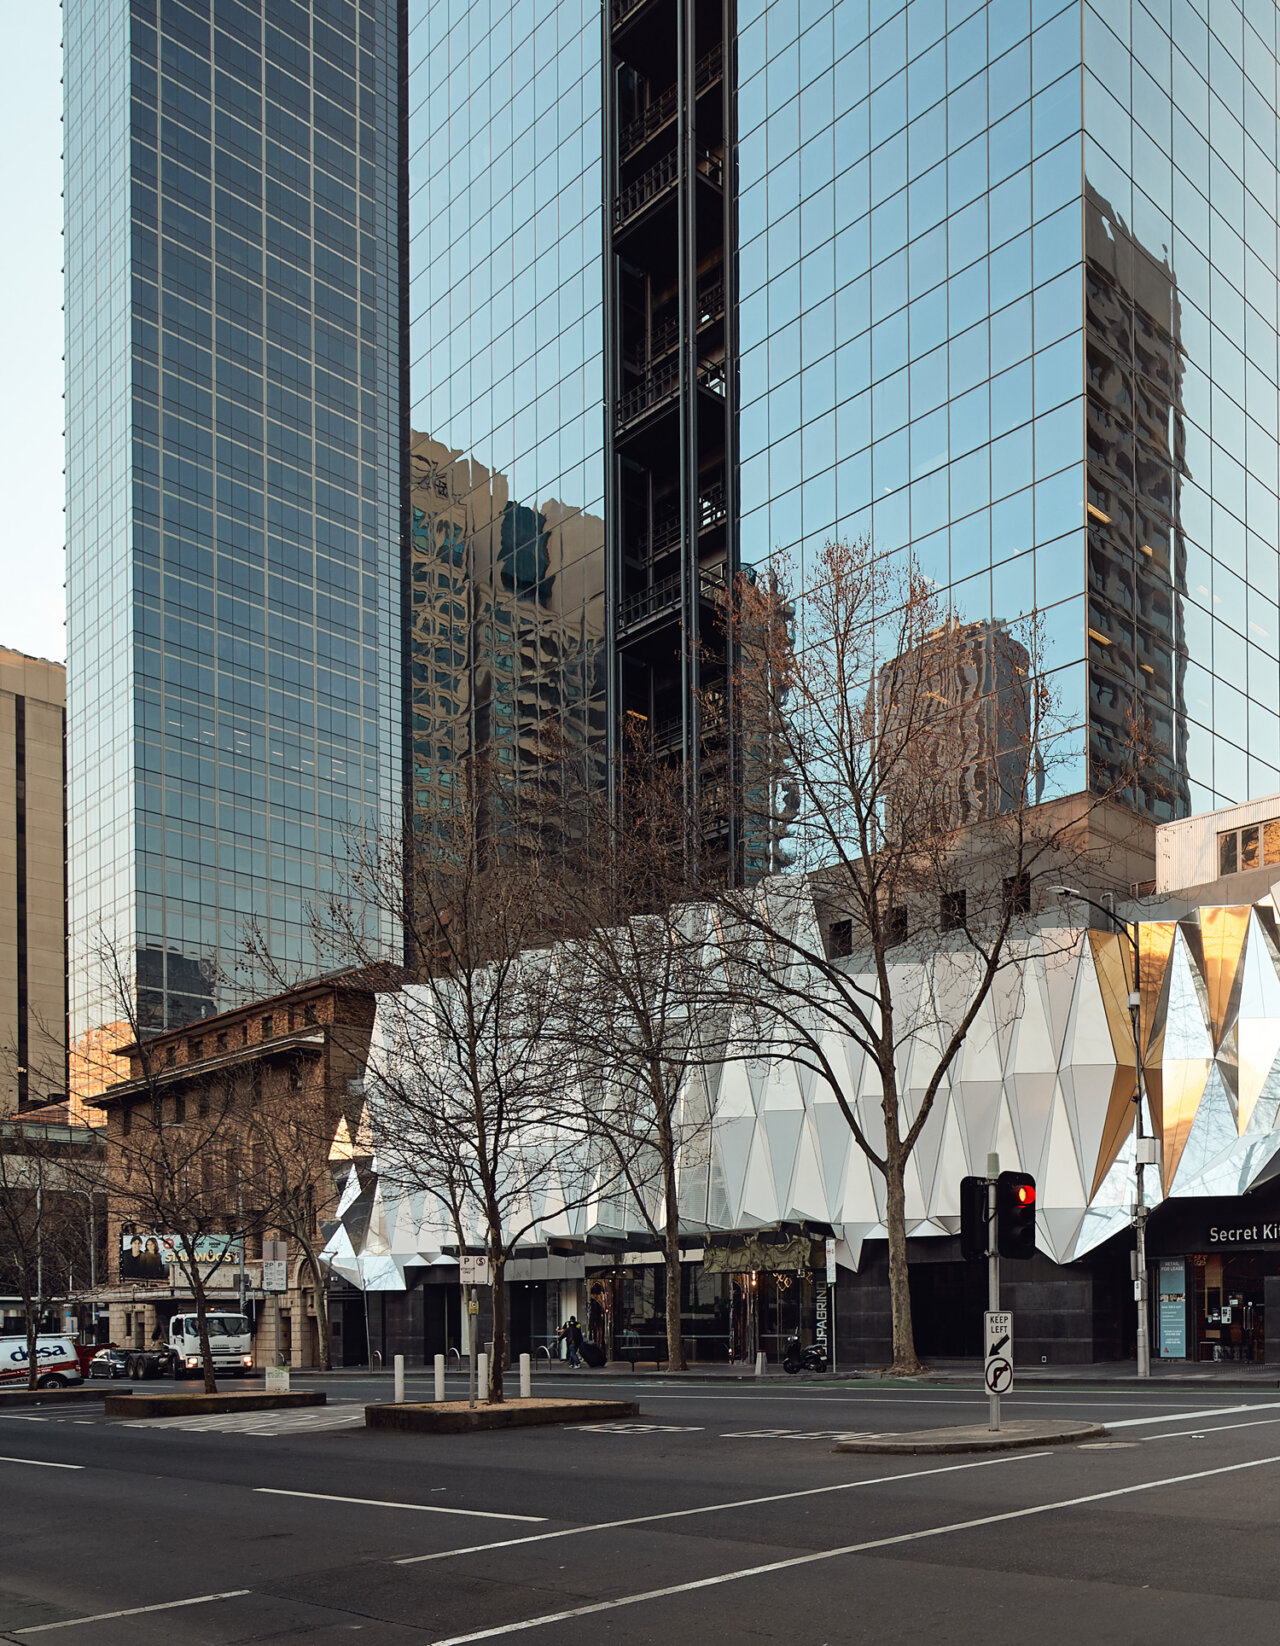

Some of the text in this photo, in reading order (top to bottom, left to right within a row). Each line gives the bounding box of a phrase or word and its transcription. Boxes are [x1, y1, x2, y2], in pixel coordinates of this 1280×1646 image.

[1210, 1226, 1258, 1242] Secret
[464, 1257, 470, 1265] P
[990, 1316, 1008, 1324] KEEP
[990, 1325, 1008, 1333] LEFT
